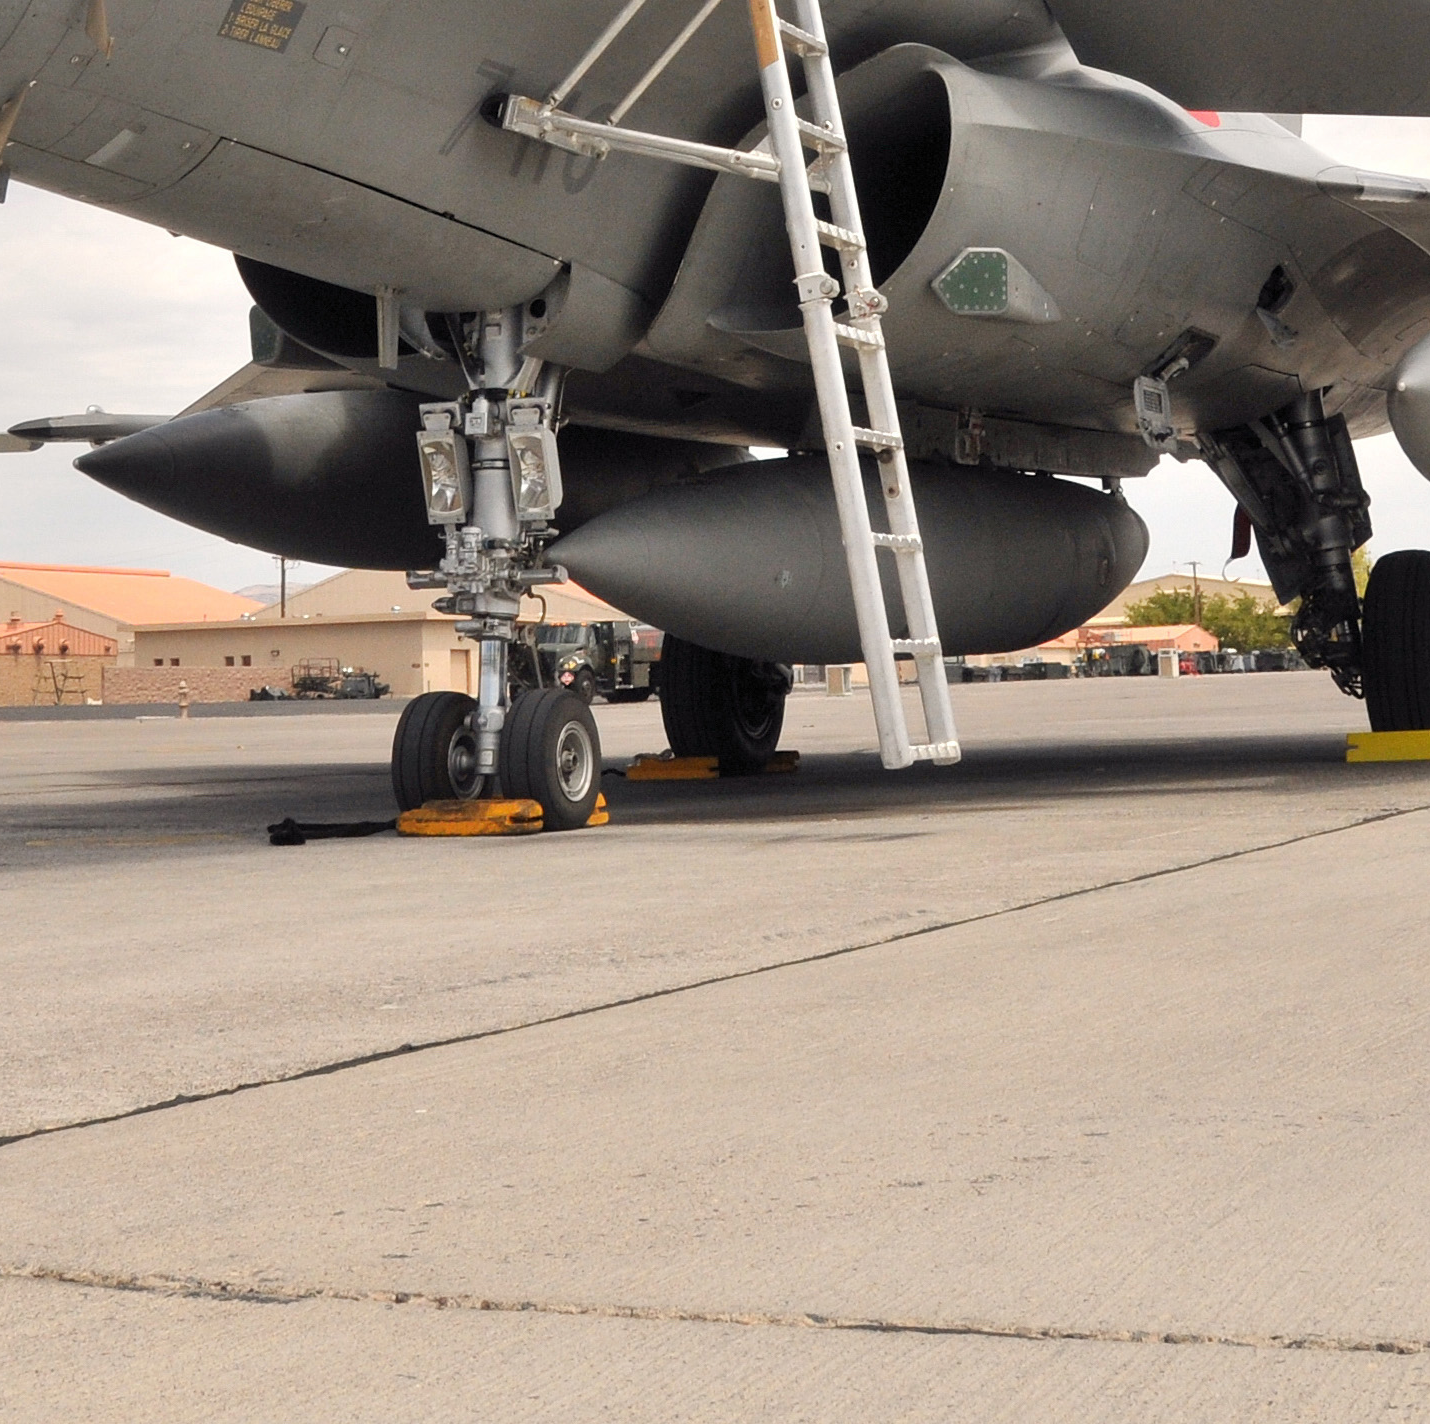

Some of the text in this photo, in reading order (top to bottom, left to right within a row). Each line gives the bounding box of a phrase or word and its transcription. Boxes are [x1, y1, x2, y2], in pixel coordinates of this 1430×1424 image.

[230, 25, 251, 41] TIRER
[235, 14, 260, 30] BRISER
[258, 22, 270, 33] LA
[270, 24, 292, 40] GLACE
